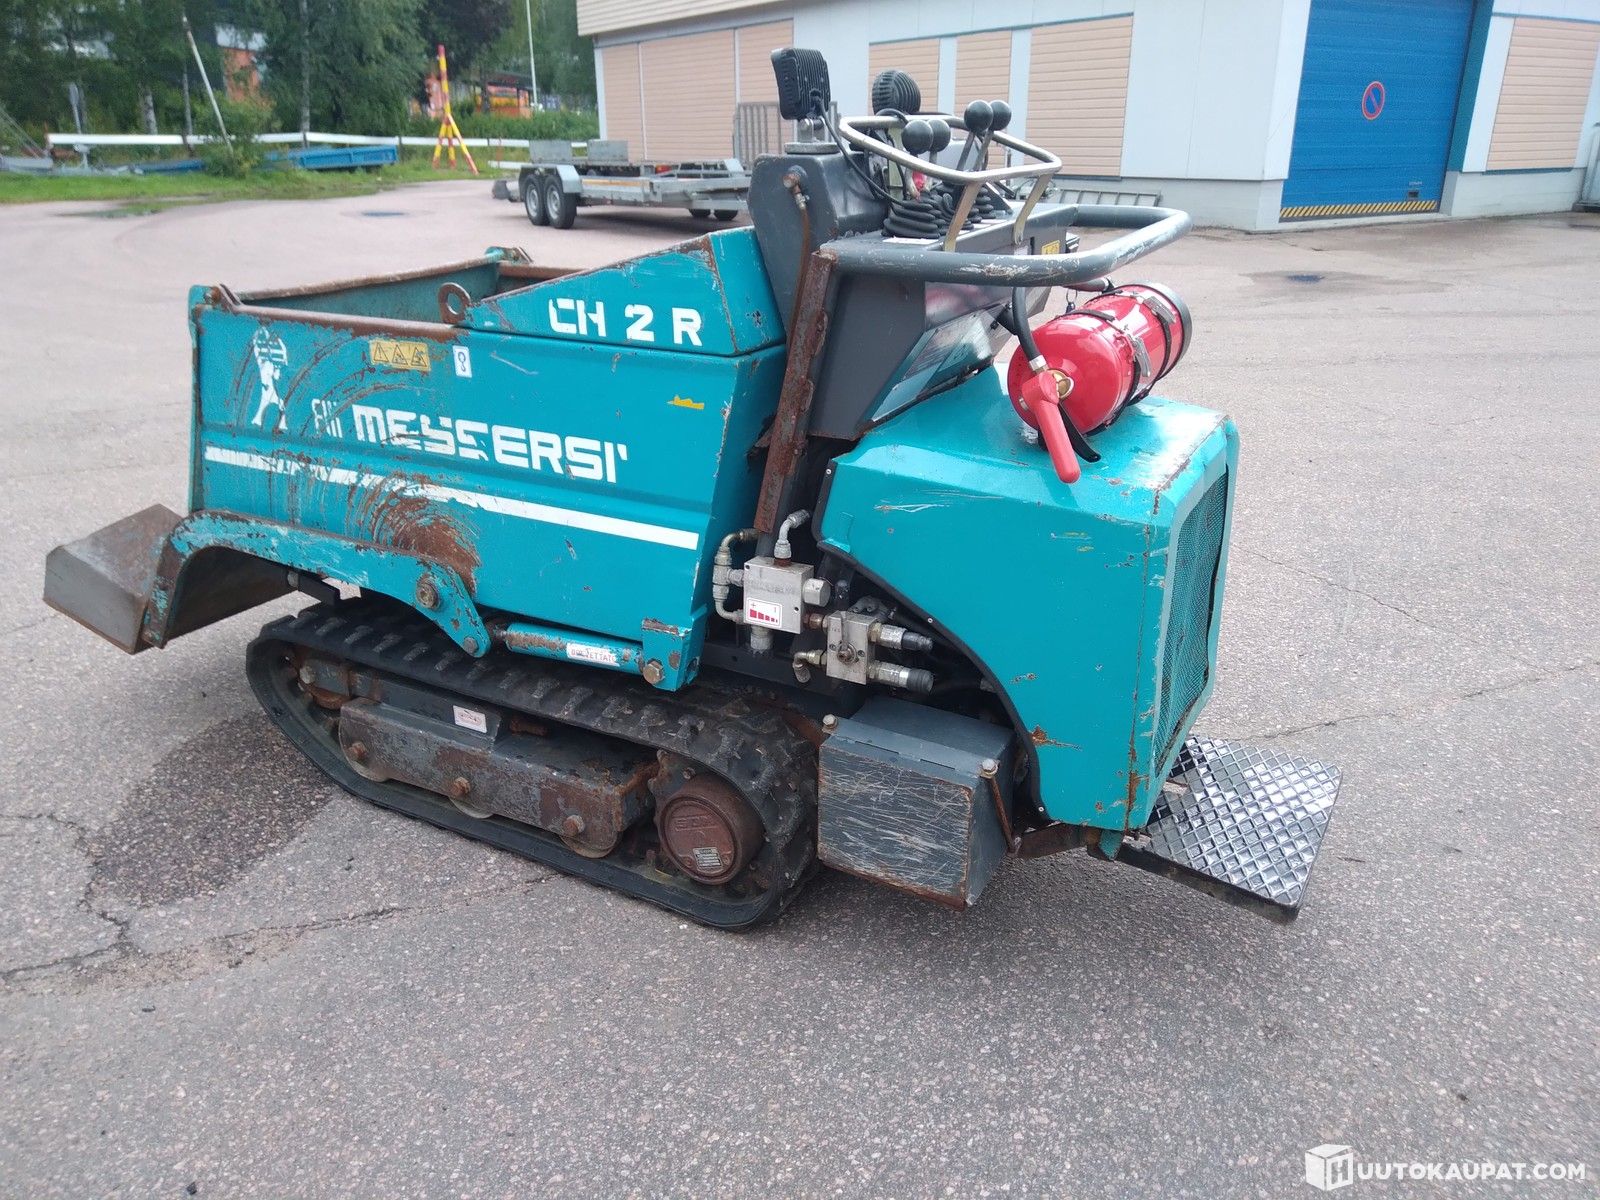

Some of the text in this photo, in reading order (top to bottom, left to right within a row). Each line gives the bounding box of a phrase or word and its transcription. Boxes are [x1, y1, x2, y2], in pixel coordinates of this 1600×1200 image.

[548, 298, 703, 347] CH 2 R
